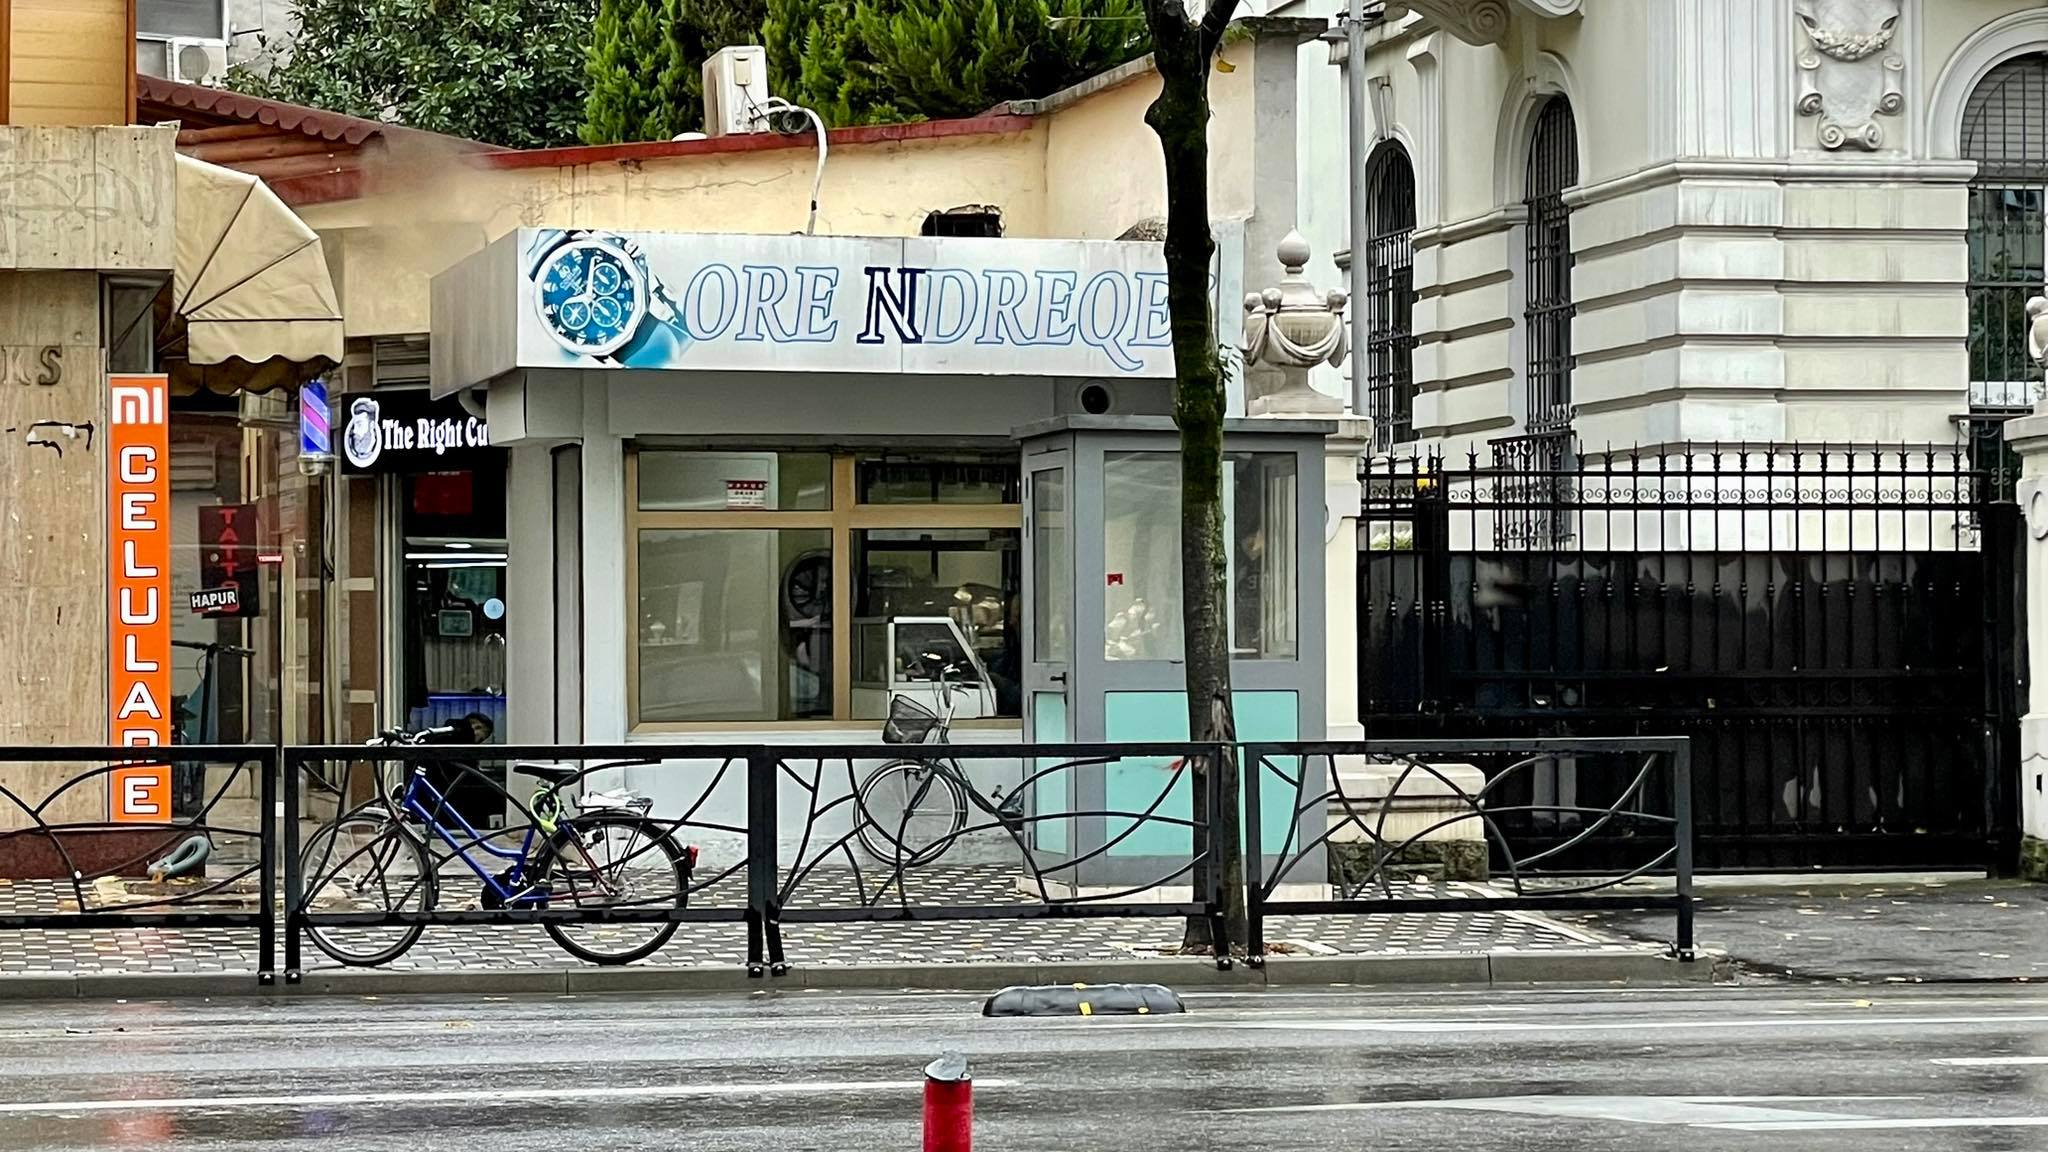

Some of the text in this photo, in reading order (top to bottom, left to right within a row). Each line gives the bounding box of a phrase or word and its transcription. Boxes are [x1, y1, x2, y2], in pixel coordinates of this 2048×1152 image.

[685, 265, 1217, 371] ORE NDREQE
[382, 419, 414, 450] The
[417, 417, 463, 455] Right
[117, 445, 163, 815] CELULARE
[191, 591, 236, 608] HAPUR
